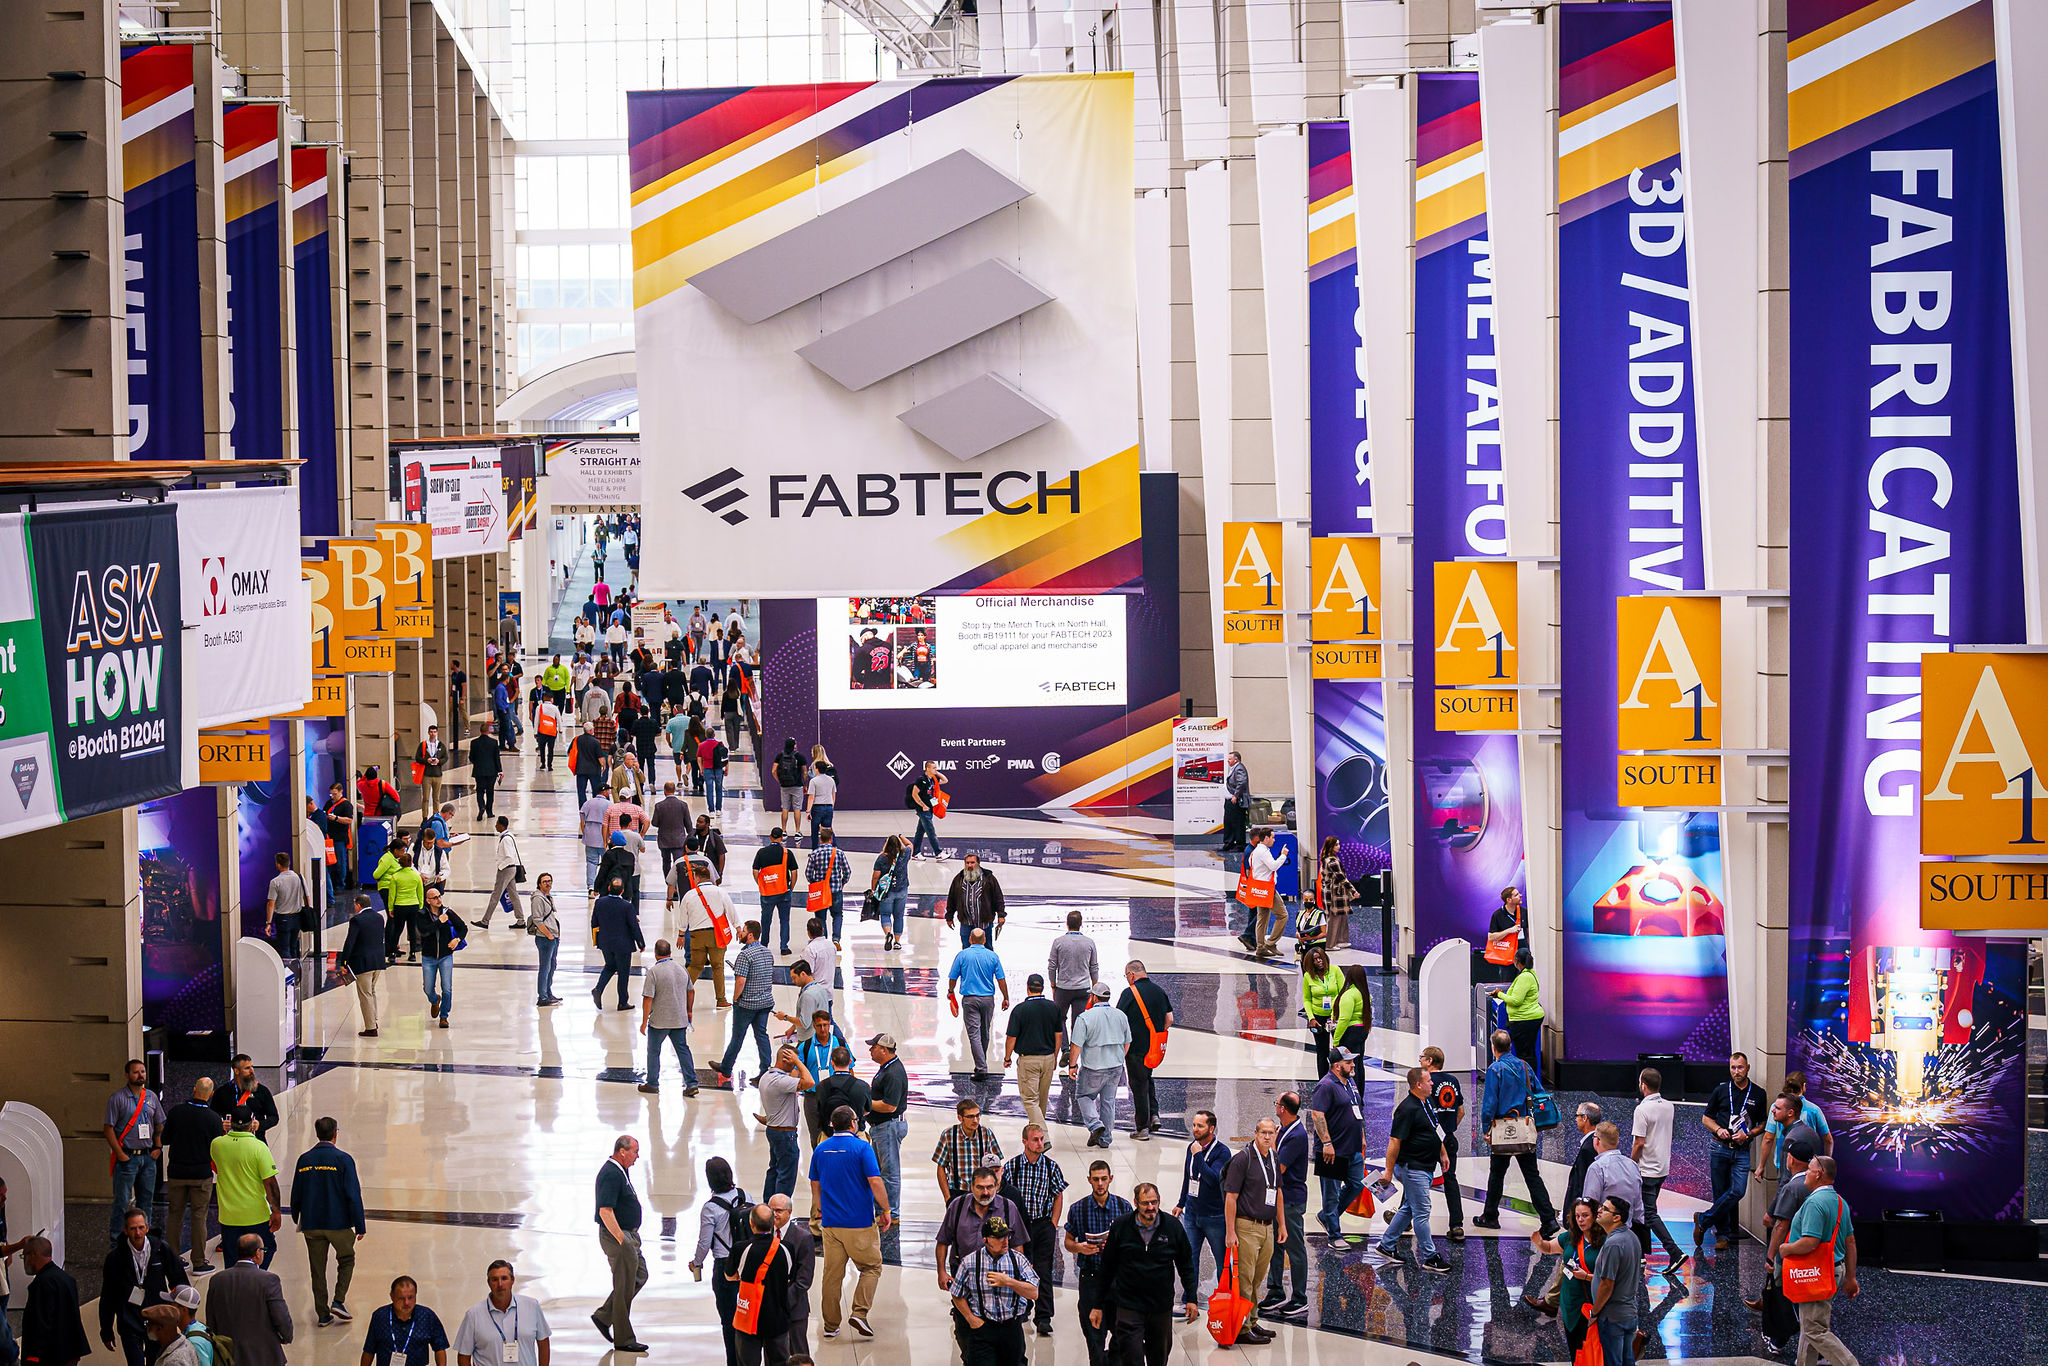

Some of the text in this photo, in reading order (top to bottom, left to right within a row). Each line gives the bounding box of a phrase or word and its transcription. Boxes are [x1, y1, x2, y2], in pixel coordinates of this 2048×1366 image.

[1628, 167, 1684, 258] 3D
[1628, 310, 1684, 591] ADDITIV
[1864, 149, 1953, 816] FABRICATING
[770, 470, 1080, 518] FABTECH
[588, 505, 636, 513] LAKES
[232, 570, 269, 596] OMAX
[66, 563, 163, 653] ASK
[976, 596, 1094, 607] Official Merchandise
[394, 616, 430, 626] ORTH
[962, 621, 980, 630] Stop
[982, 621, 991, 630] by
[1227, 619, 1280, 631] SOUTH
[204, 630, 243, 647] Booth A4531
[1032, 632, 1048, 640] your
[345, 646, 391, 658] ORTH
[1000, 642, 1029, 651] apparel
[1316, 651, 1377, 664] SOUTH
[66, 645, 163, 727] HOW
[1055, 682, 1115, 691] FABTECH
[1440, 697, 1514, 713] SOUTH
[69, 718, 165, 759] @Booth B12041
[200, 745, 265, 762] ORTH
[894, 760, 908, 770] AWS
[923, 761, 956, 770] MA
[966, 760, 991, 769] sme
[1008, 760, 1035, 769] PMA
[1625, 765, 1716, 785] SOUTH
[1930, 874, 2048, 902] SOUTH
[1790, 1266, 1821, 1279] Mazak
